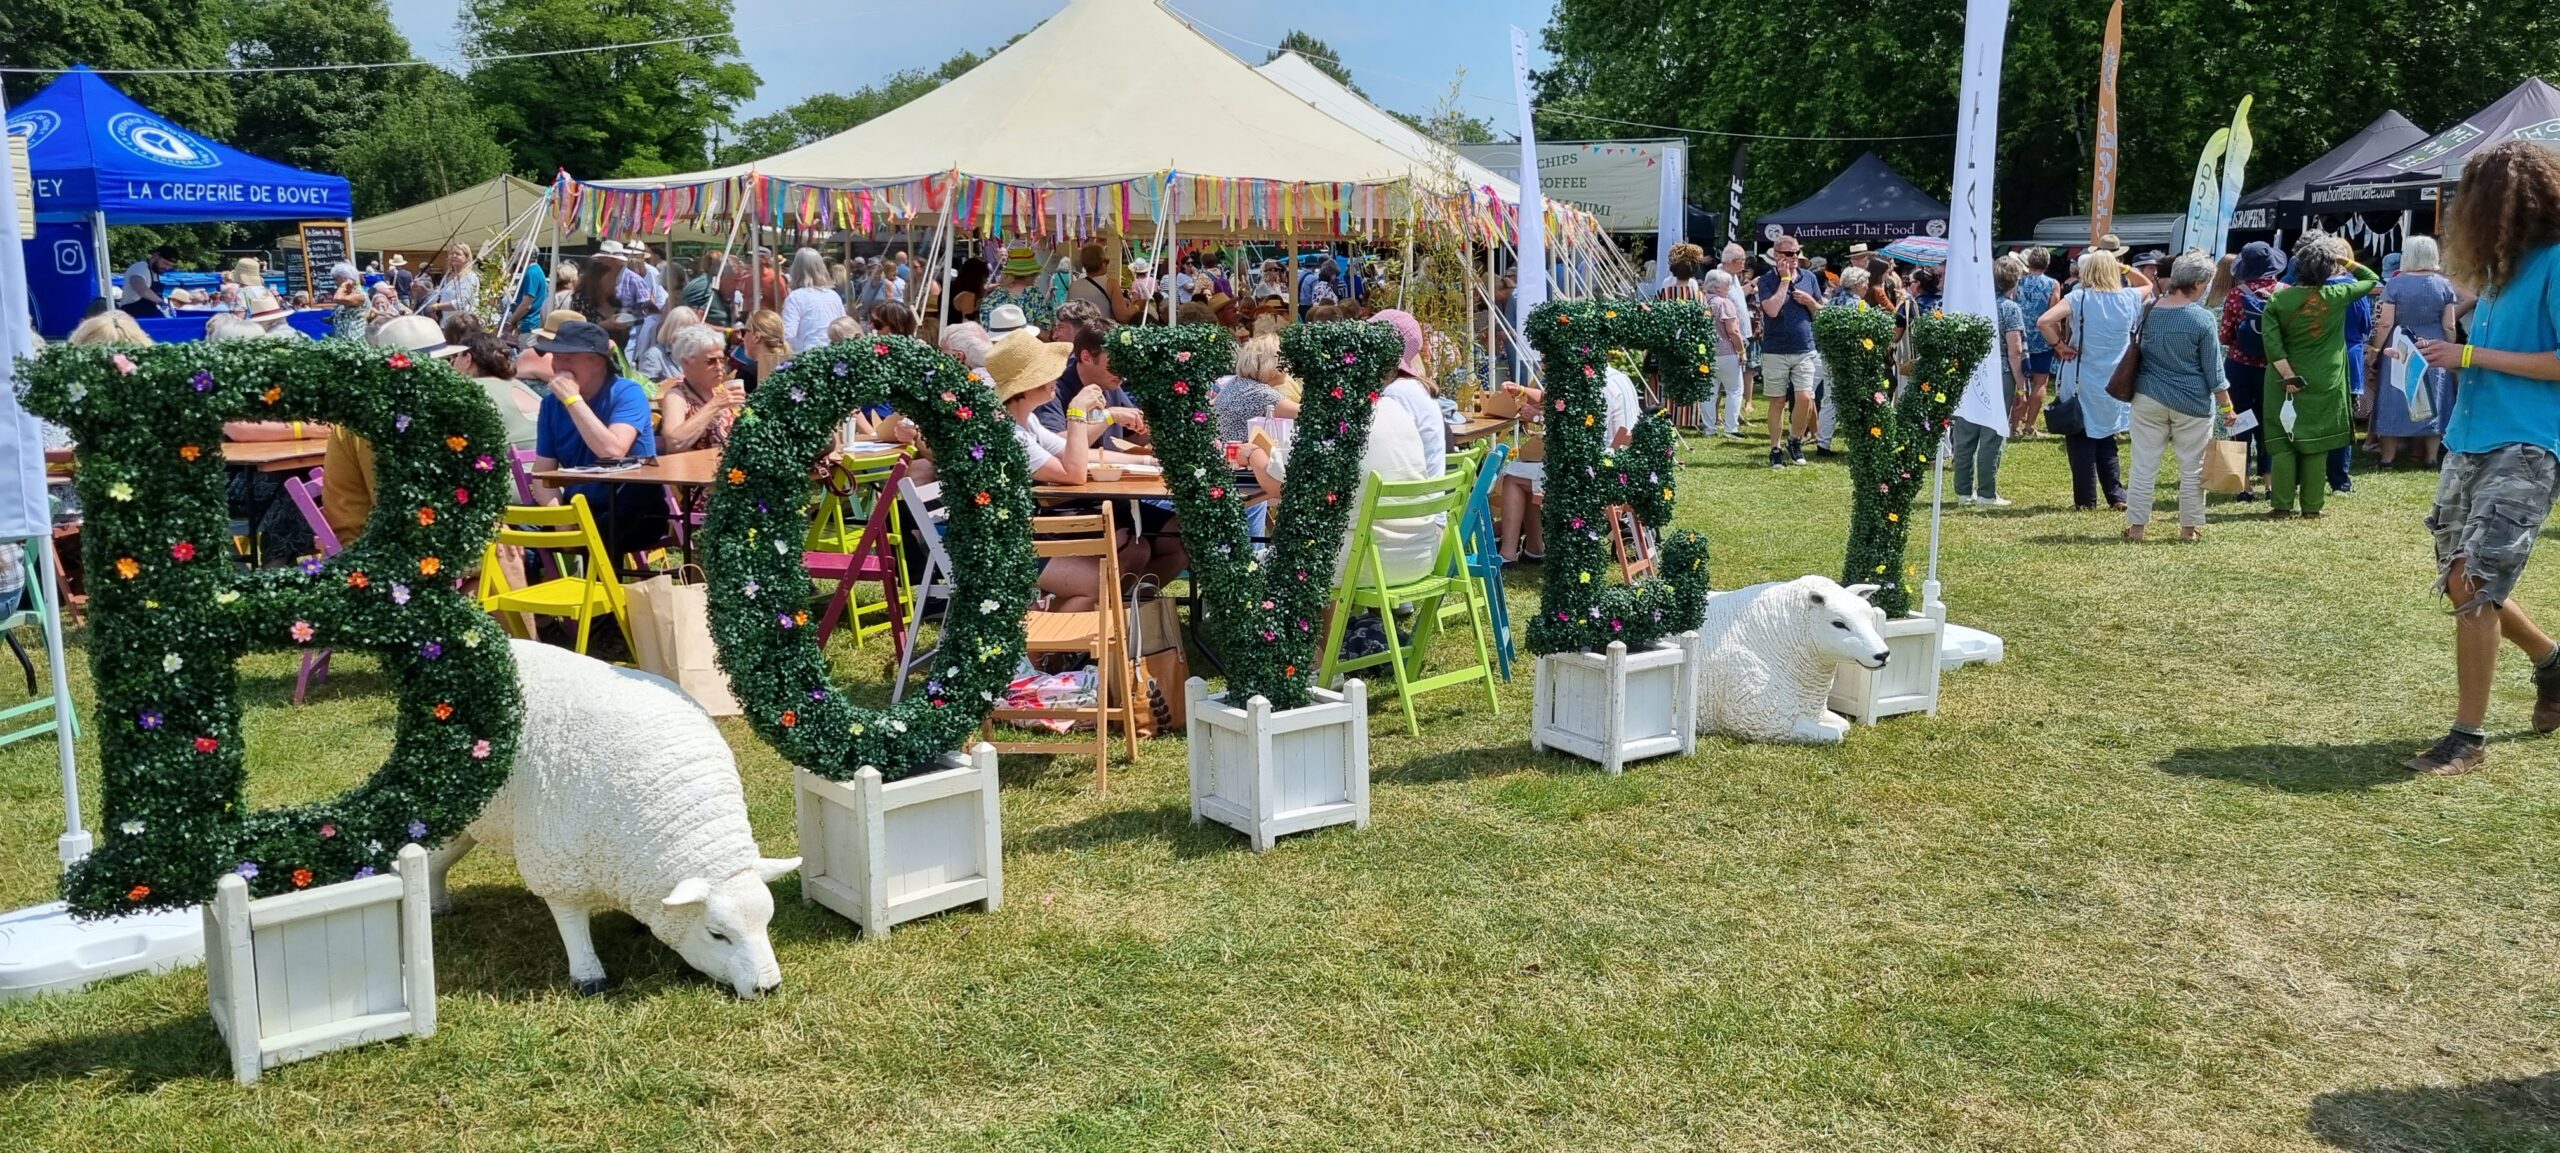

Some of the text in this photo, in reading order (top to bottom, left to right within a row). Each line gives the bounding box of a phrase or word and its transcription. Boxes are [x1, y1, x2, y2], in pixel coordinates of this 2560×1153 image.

[1537, 153, 1578, 169] CHIPS
[128, 182, 329, 203] LA CREPERIE DE BOVEY
[1793, 223, 1915, 238] Authentic Thai Food
